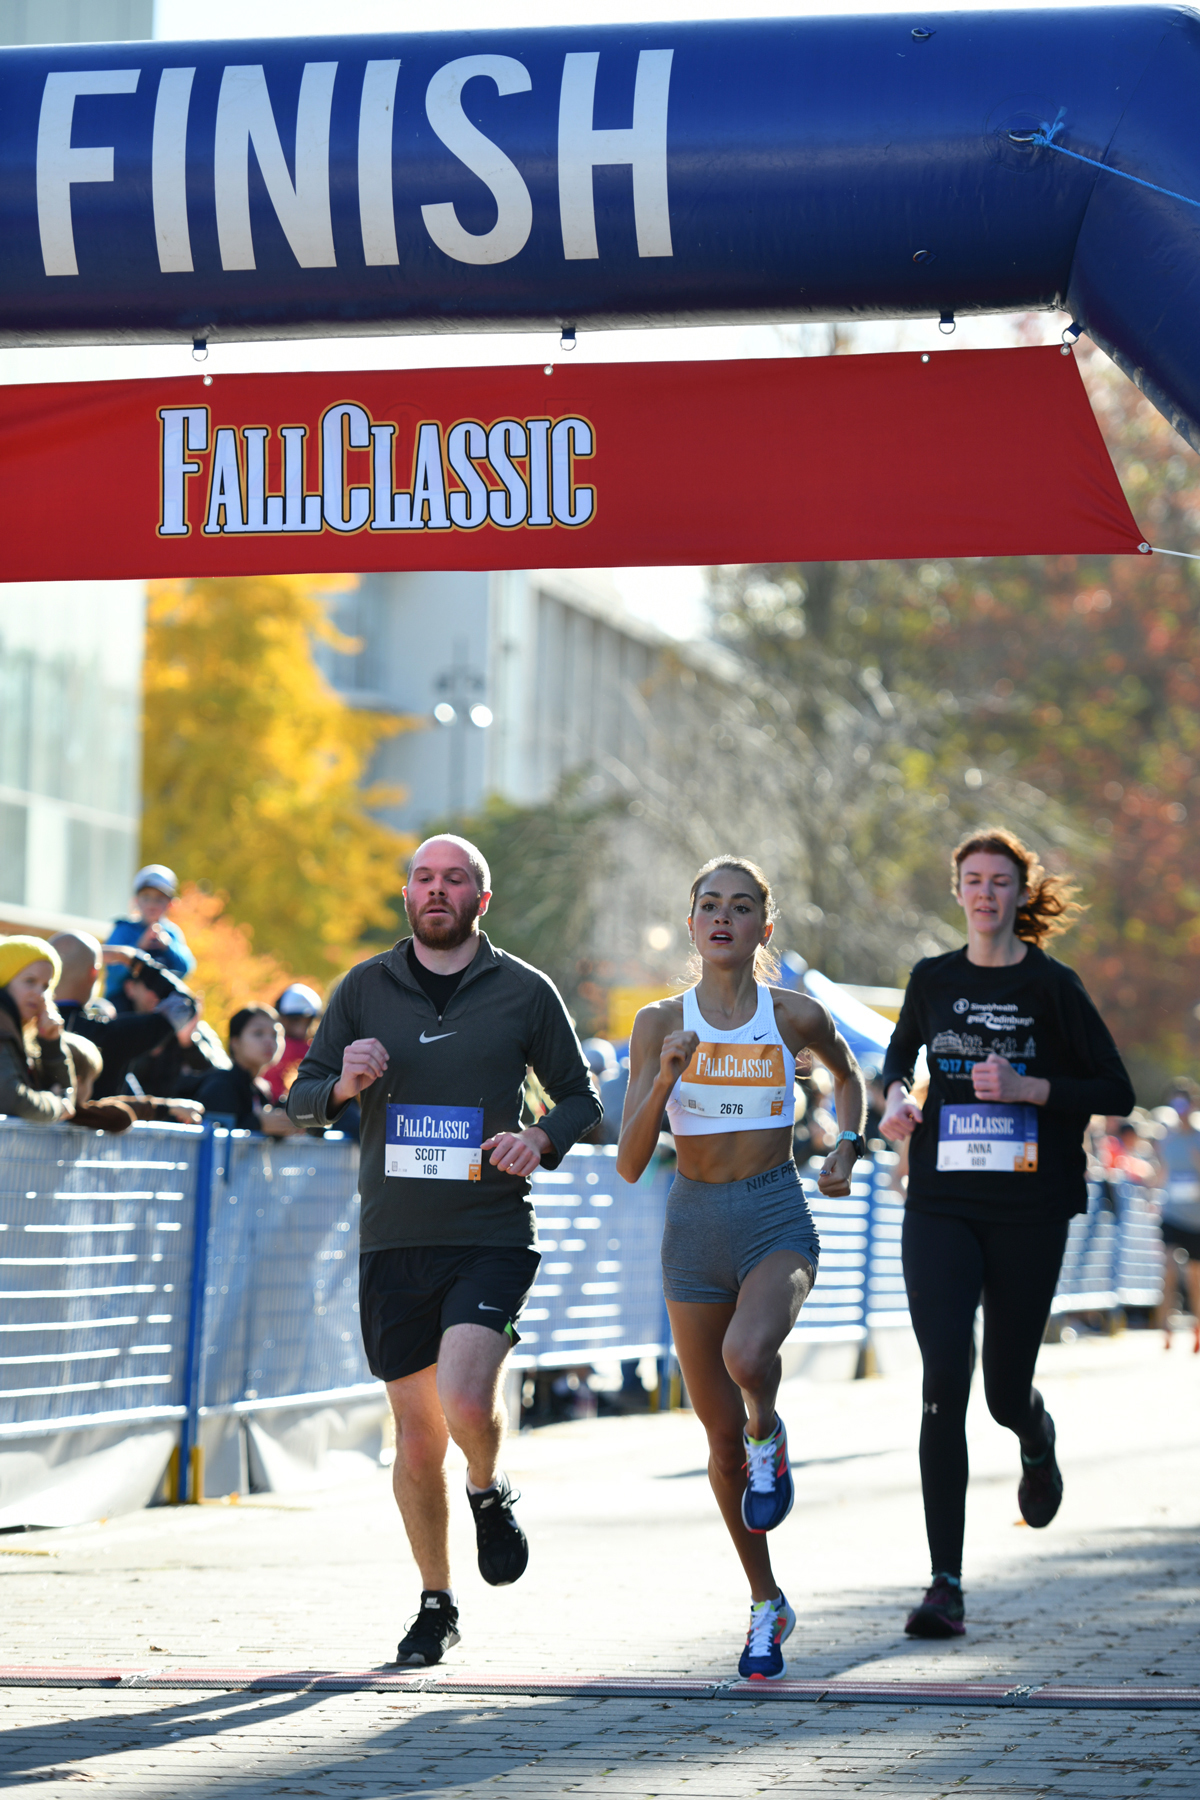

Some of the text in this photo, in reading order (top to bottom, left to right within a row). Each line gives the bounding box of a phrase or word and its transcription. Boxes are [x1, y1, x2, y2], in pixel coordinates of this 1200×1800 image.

[36, 48, 675, 276] FINISH
[720, 1103, 743, 1115] 2676
[415, 1148, 446, 1161] SCOTT
[967, 1142, 992, 1155] ANNA
[423, 1164, 438, 1175] 166
[746, 1170, 780, 1193] NIKE
